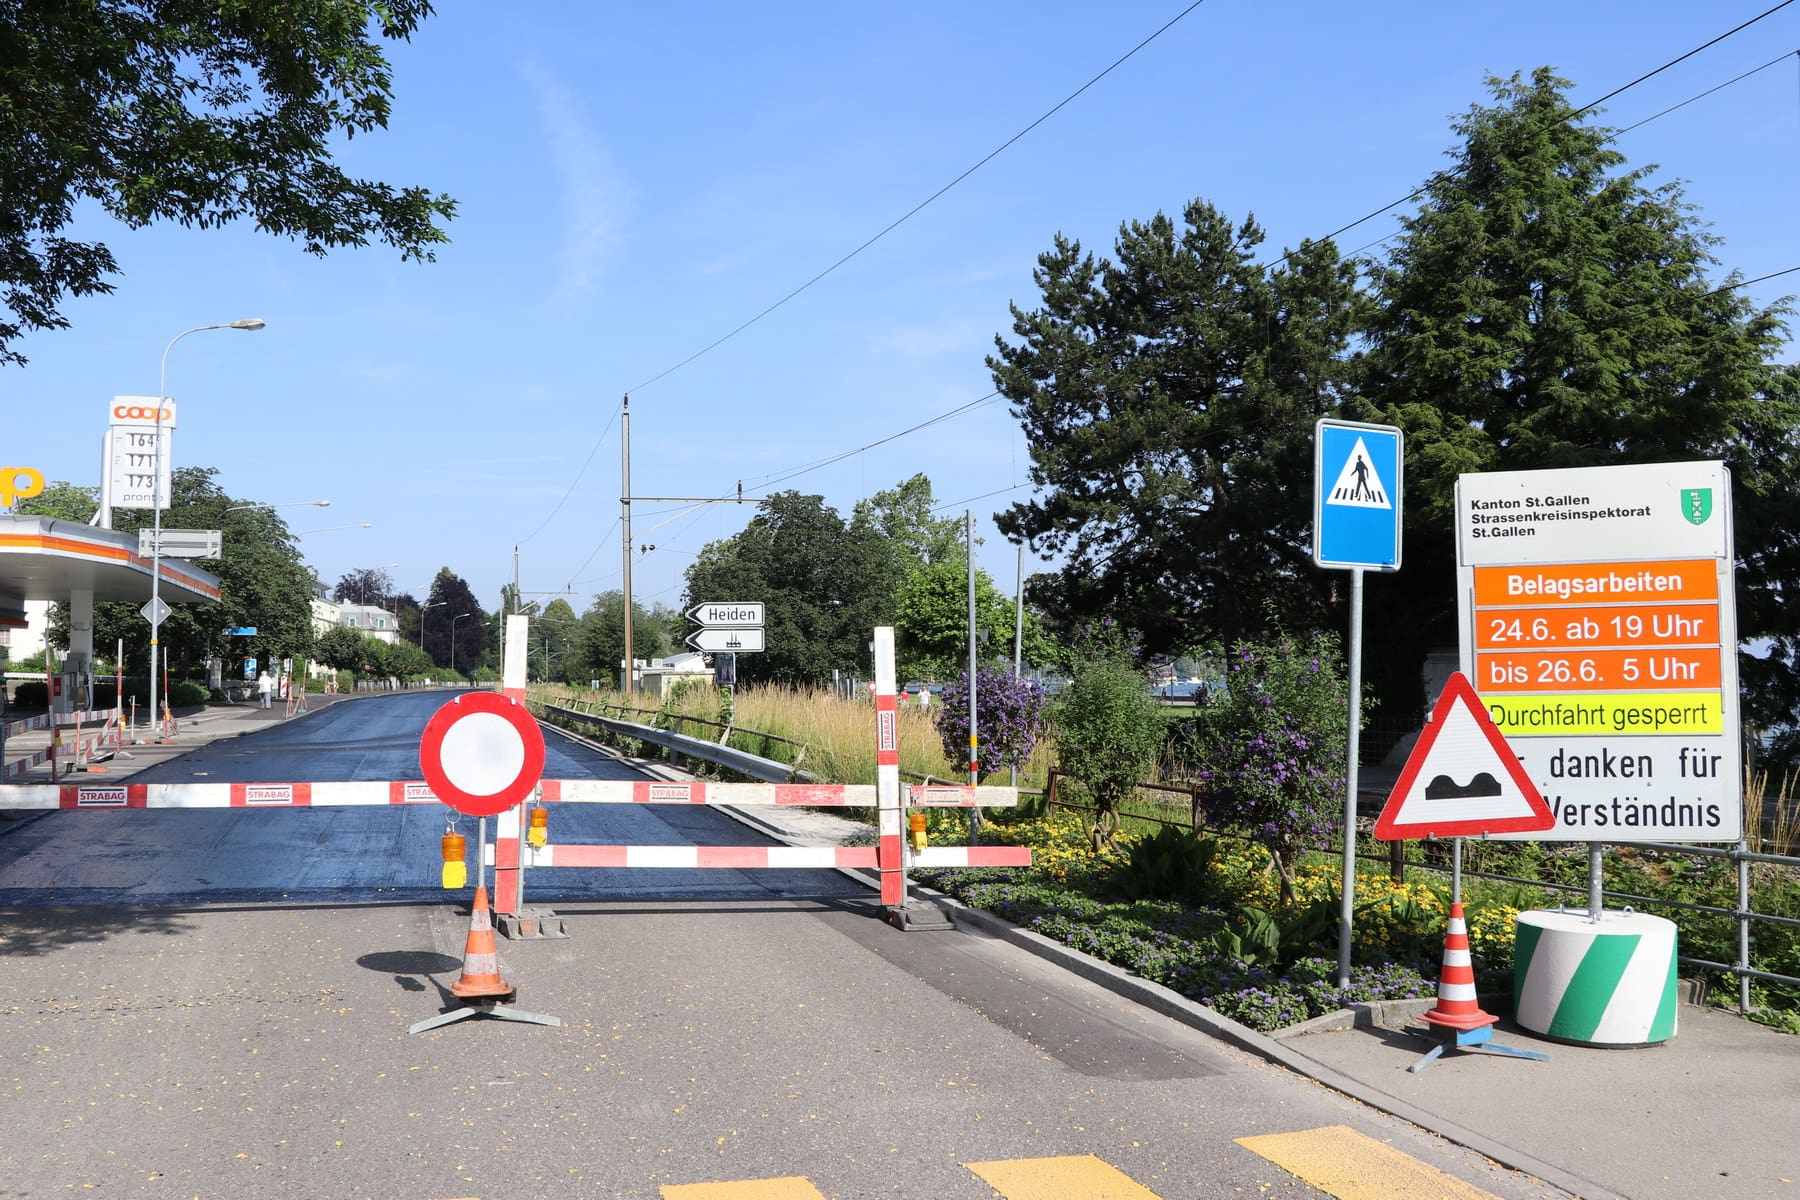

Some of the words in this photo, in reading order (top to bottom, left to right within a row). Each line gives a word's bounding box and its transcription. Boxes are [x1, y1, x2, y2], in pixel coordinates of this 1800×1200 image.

[113, 405, 172, 424] coop
[130, 433, 154, 447] 164
[129, 453, 152, 468] 171
[0, 466, 46, 507] p
[128, 473, 153, 488] 173
[123, 494, 164, 503] prono
[1471, 499, 1521, 511] Kanton
[1525, 495, 1590, 508] St.Gallen
[1471, 506, 1651, 524] Strassenkreisinspektorat
[1472, 526, 1536, 538] St.Gallen
[1507, 571, 1683, 599] Belagsarbeiten
[709, 607, 756, 621] Heiden
[1490, 617, 1556, 642] 24.6.
[1566, 617, 1600, 640] ab
[1610, 615, 1643, 638] 19
[1653, 614, 1704, 637] Uhr
[1490, 661, 1529, 684] bis
[1537, 659, 1604, 682] 26.6.
[1622, 658, 1640, 681] 5
[1649, 657, 1701, 680] Uhr
[1490, 704, 1606, 726] Durchfahrt
[1613, 703, 1708, 731] gesperrt
[883, 712, 892, 751] STRABAG
[1550, 748, 1653, 778] danken
[1678, 747, 1722, 778] für
[80, 792, 126, 801] STRABAG
[248, 790, 290, 799] STRABAG
[406, 788, 435, 797] STRAB
[651, 789, 689, 798] STRABAG
